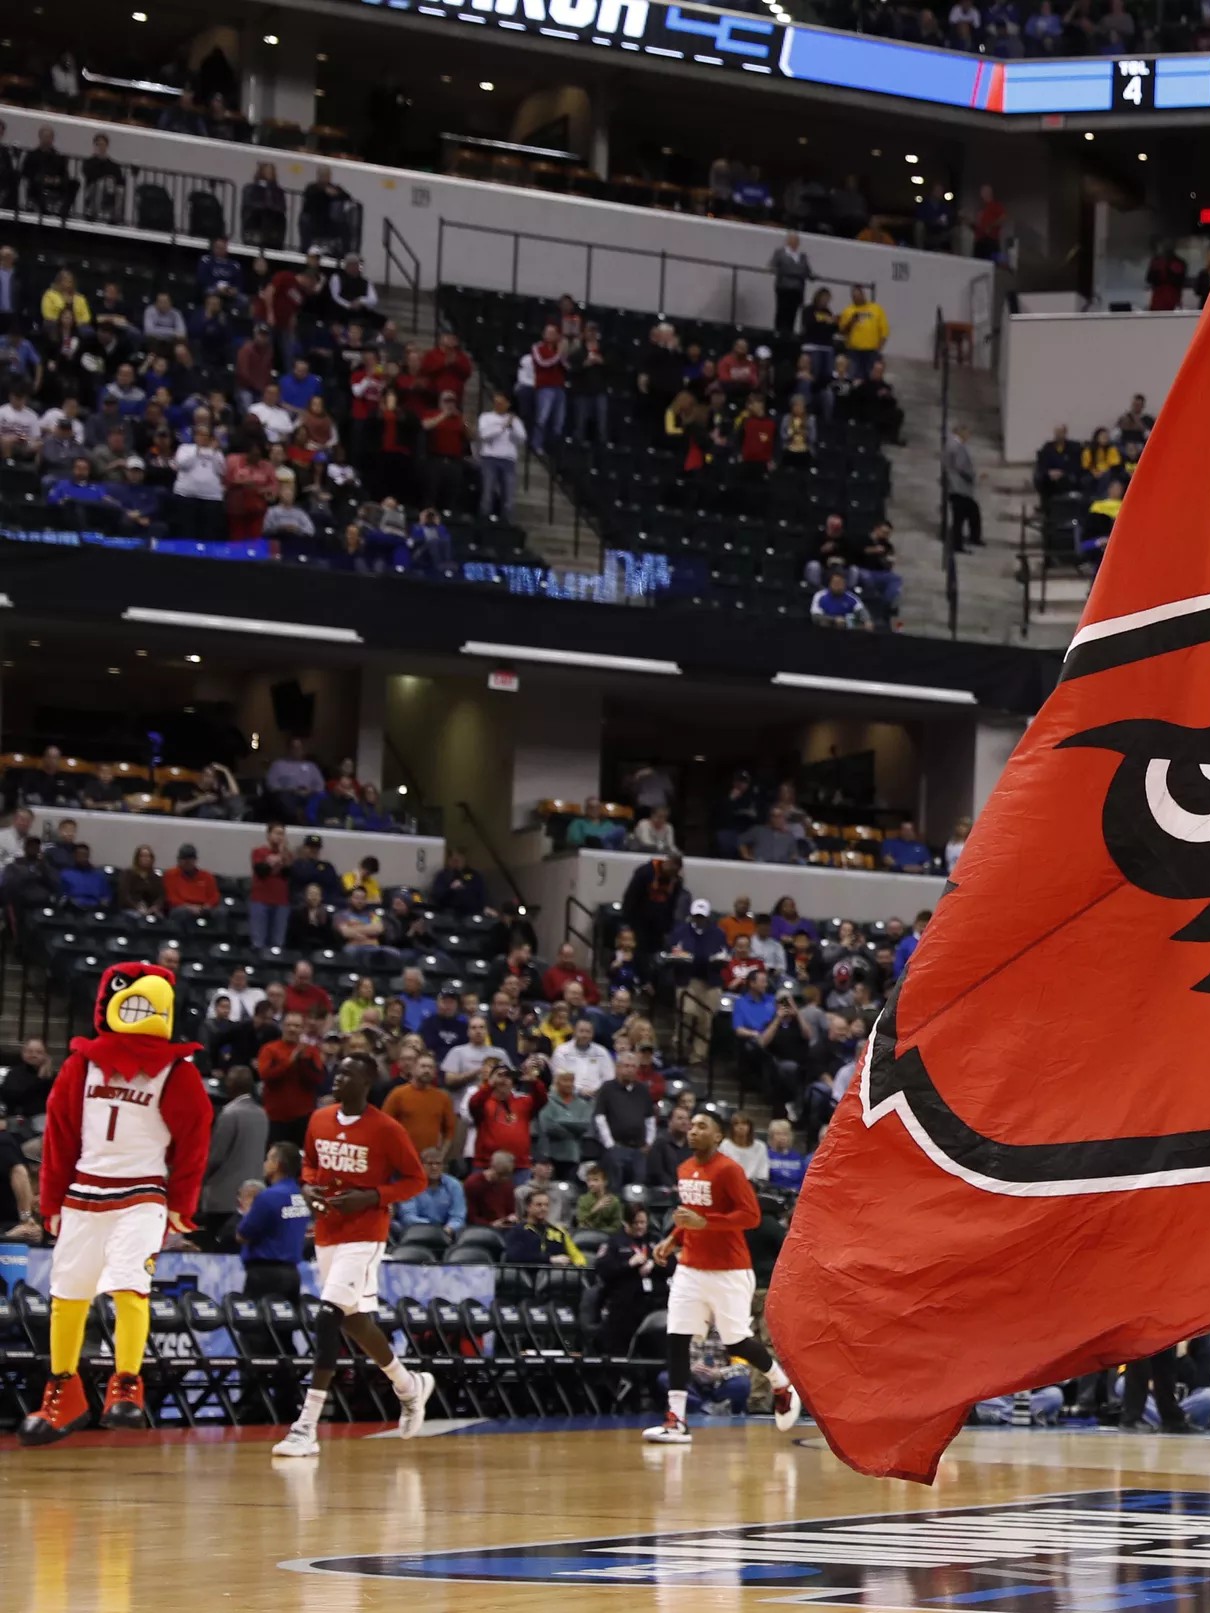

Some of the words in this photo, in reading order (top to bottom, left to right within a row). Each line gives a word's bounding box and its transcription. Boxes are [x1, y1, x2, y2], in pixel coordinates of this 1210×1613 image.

[1122, 75, 1143, 105] 4
[106, 1105, 119, 1141] 1
[315, 1138, 369, 1160] CREATE
